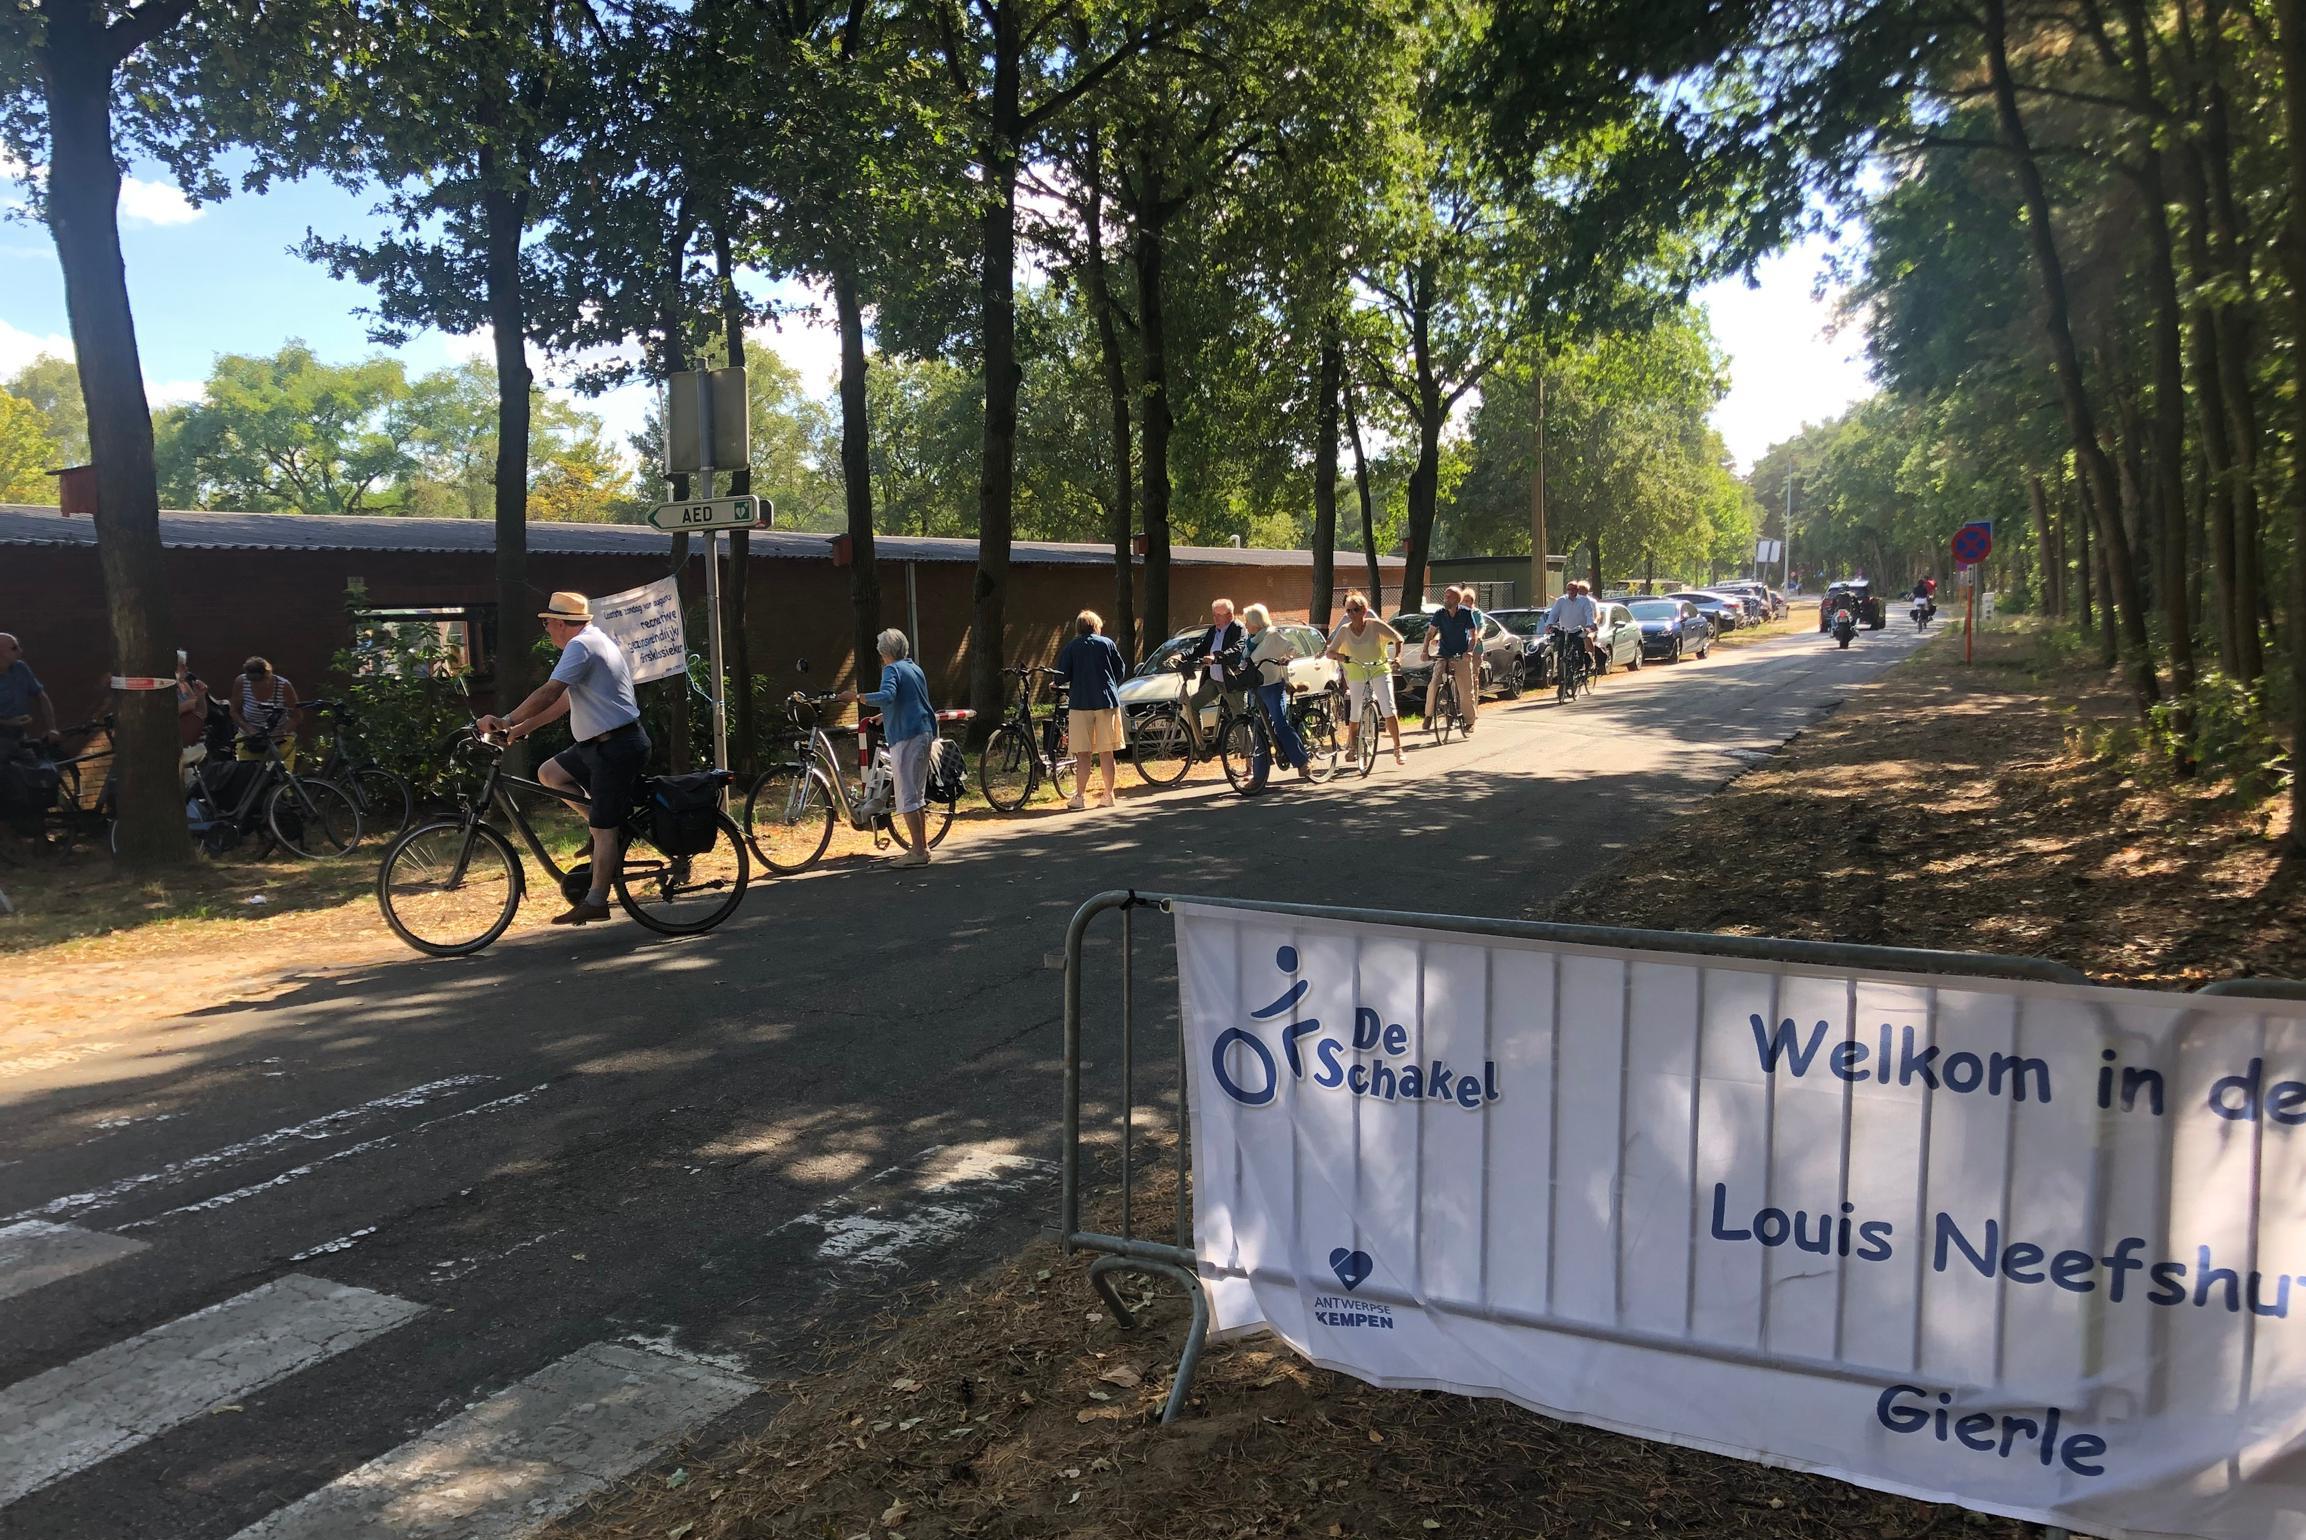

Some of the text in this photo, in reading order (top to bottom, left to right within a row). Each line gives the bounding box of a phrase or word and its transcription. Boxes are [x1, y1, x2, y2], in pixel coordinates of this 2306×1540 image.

[682, 506, 712, 524] AED
[1352, 1006, 1408, 1055] De
[1314, 1038, 1500, 1109] Schakel
[1750, 1014, 2306, 1125] Welkom in de
[1711, 1182, 2306, 1319] Louis Neefshu
[1314, 1296, 1392, 1315] ANTWERPSE
[1314, 1311, 1394, 1329] KEMPEN
[1876, 1384, 2107, 1477] Gierle
